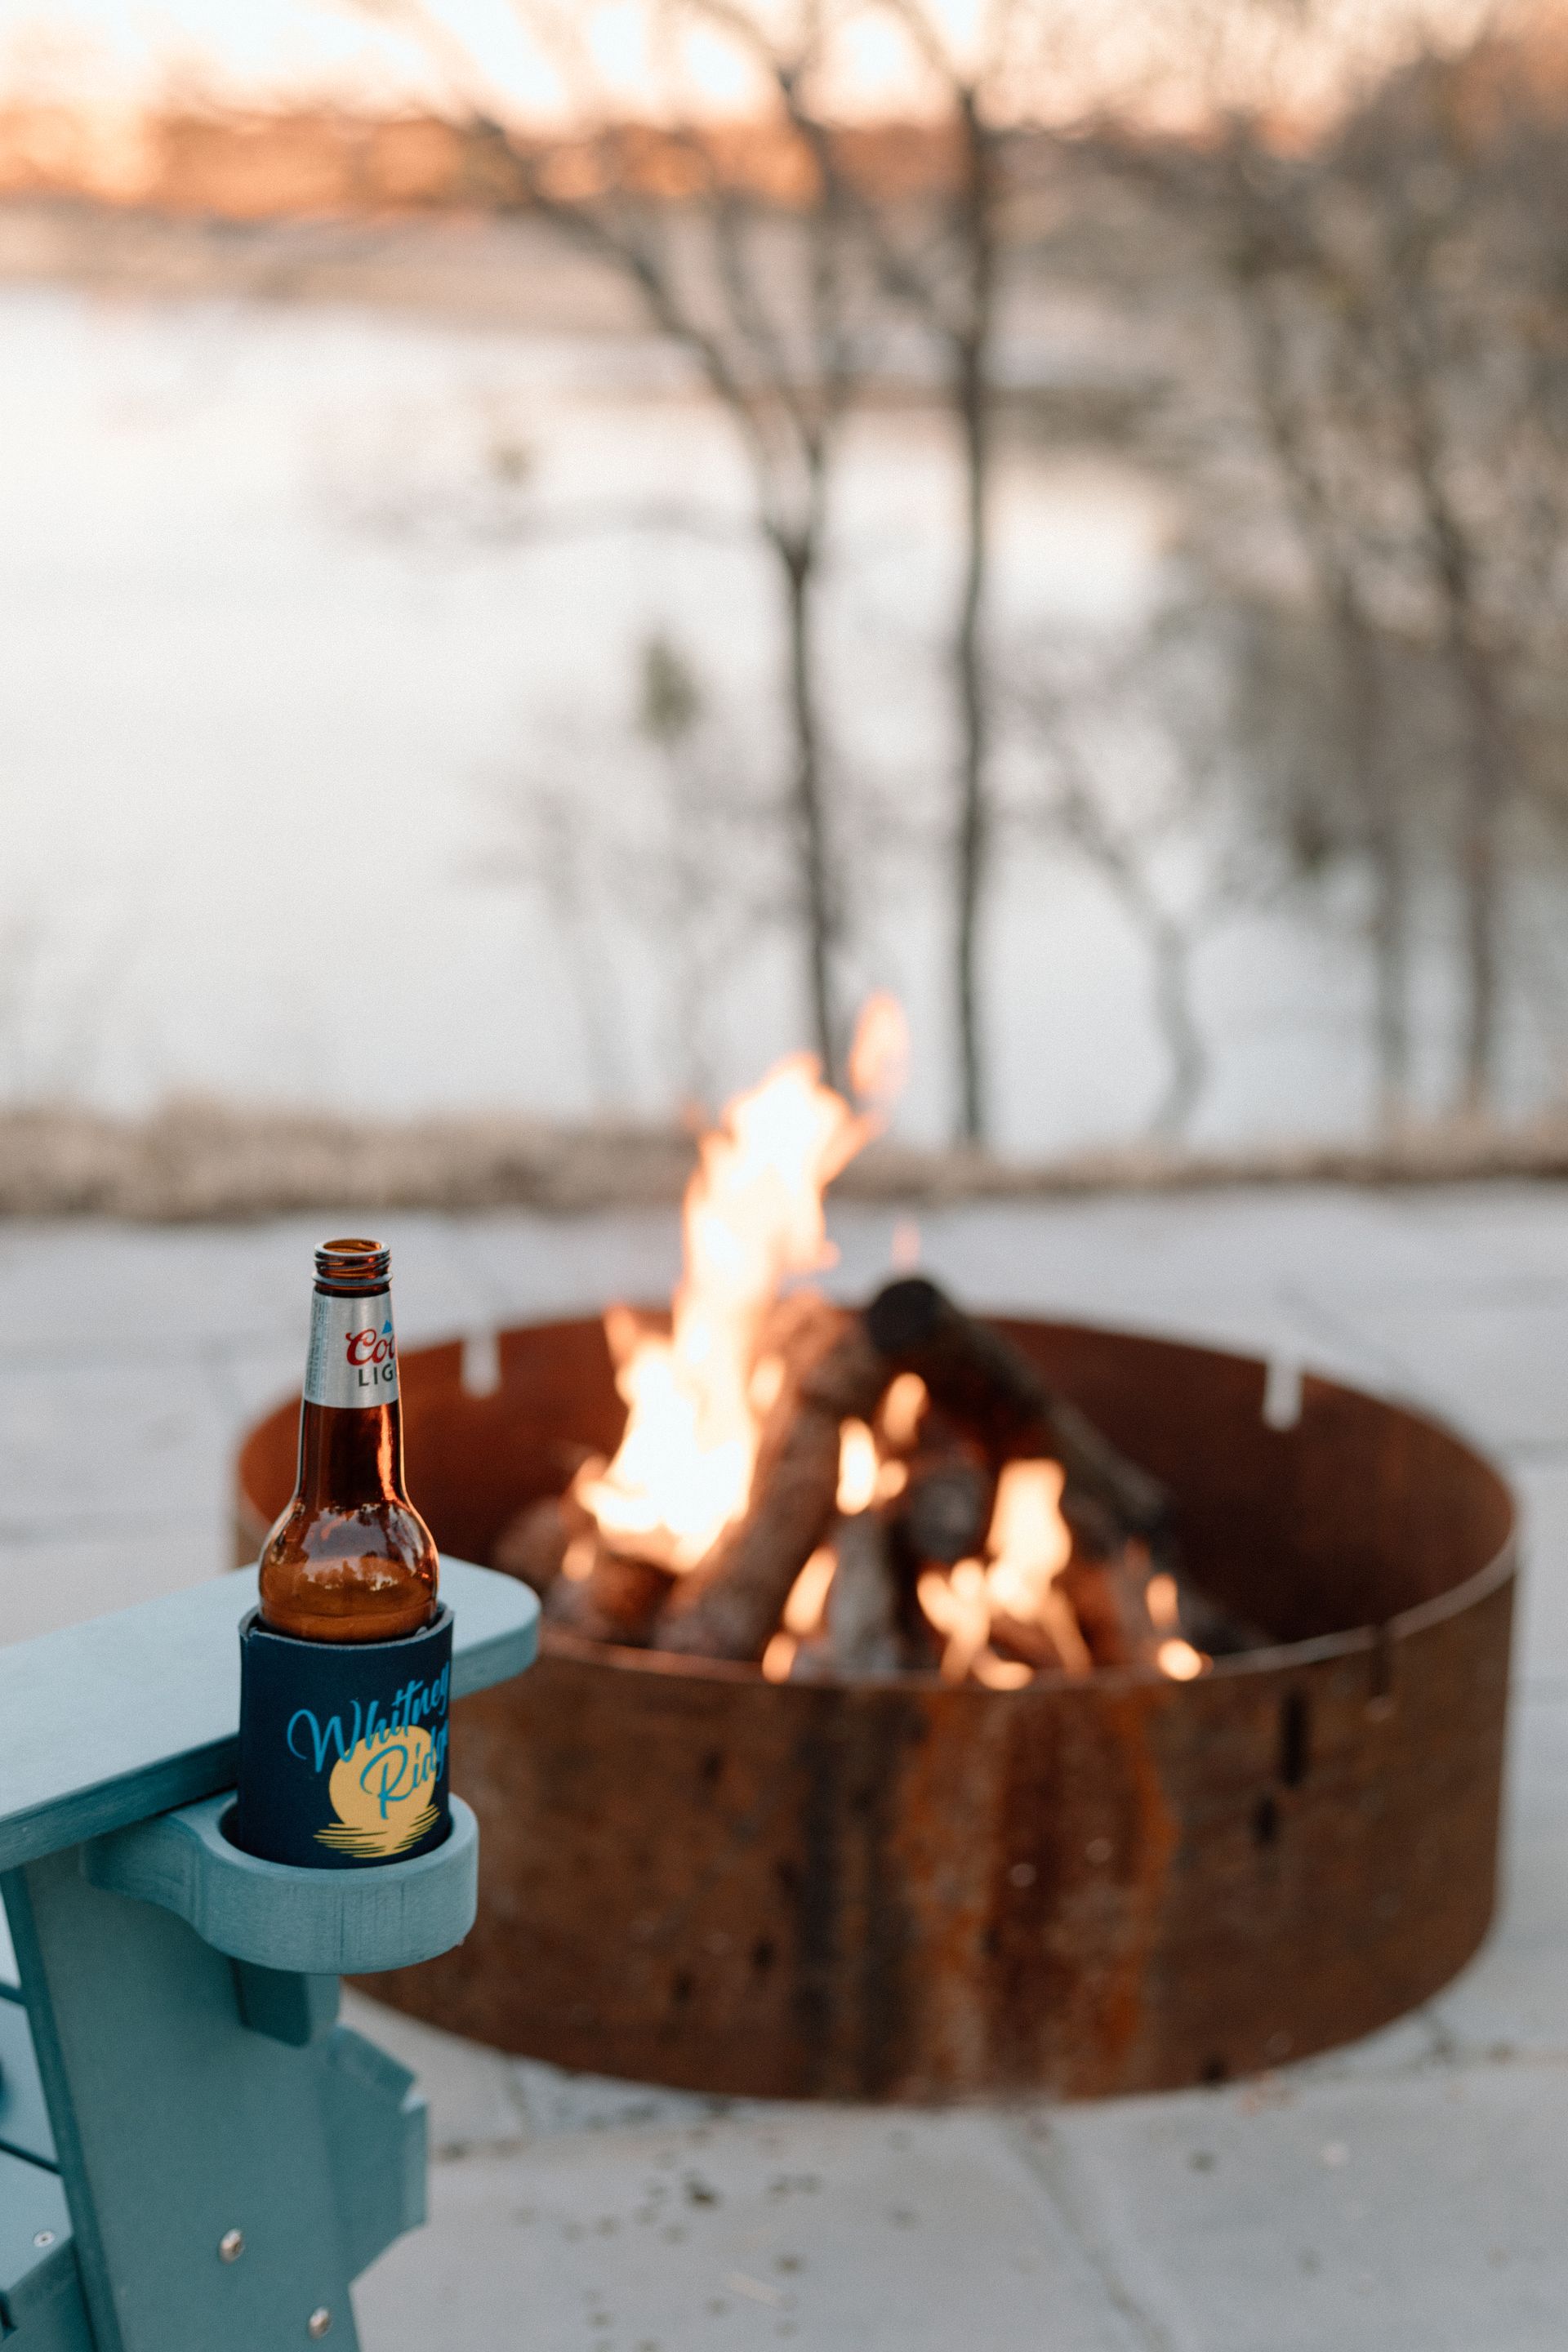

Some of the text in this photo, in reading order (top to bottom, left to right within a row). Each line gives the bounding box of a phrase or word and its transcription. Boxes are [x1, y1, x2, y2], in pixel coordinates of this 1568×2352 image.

[359, 1364, 394, 1387] LIG
[287, 1660, 449, 1773] Whitney
[360, 1719, 449, 1820] Ridg
